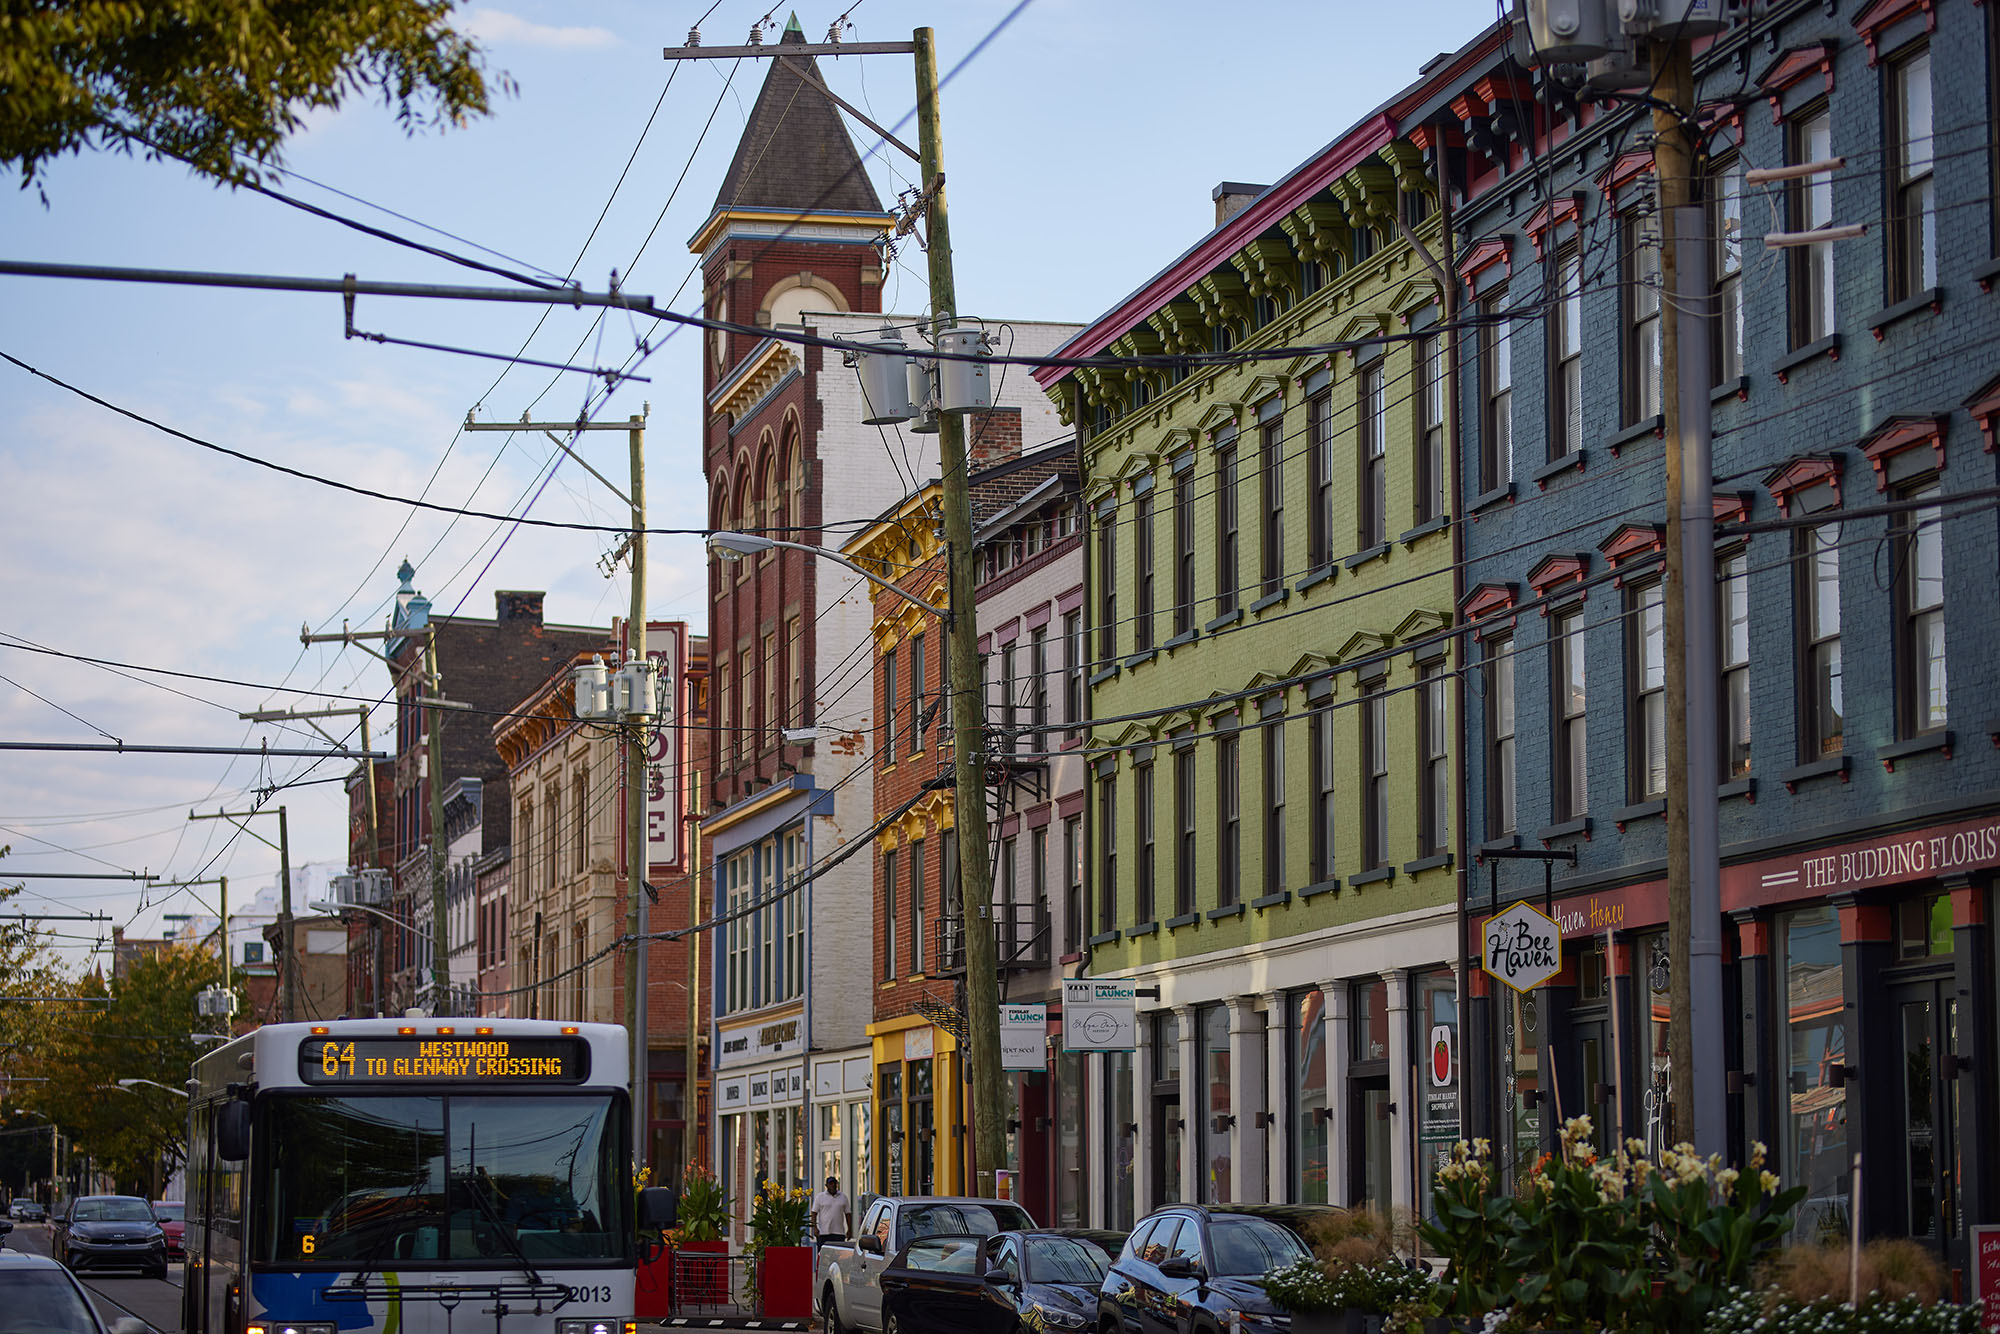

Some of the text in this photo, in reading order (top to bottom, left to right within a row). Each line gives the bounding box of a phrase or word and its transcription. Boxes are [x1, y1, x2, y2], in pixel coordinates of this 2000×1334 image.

[1803, 856, 1838, 888] THE
[1841, 841, 1926, 883] BUDDING
[1553, 898, 1624, 933] Haven Honey
[1513, 918, 1554, 951] Bee
[1488, 934, 1557, 977] Haven
[1095, 990, 1134, 998] LAUNCH
[1008, 1013, 1044, 1021] LAUNCH
[322, 1042, 355, 1075] 64
[420, 1042, 509, 1057] WESTWOOD
[365, 1058, 562, 1075] TO GLENWAY CROSSING
[302, 1235, 315, 1253] 6
[569, 1286, 611, 1303] 2013
